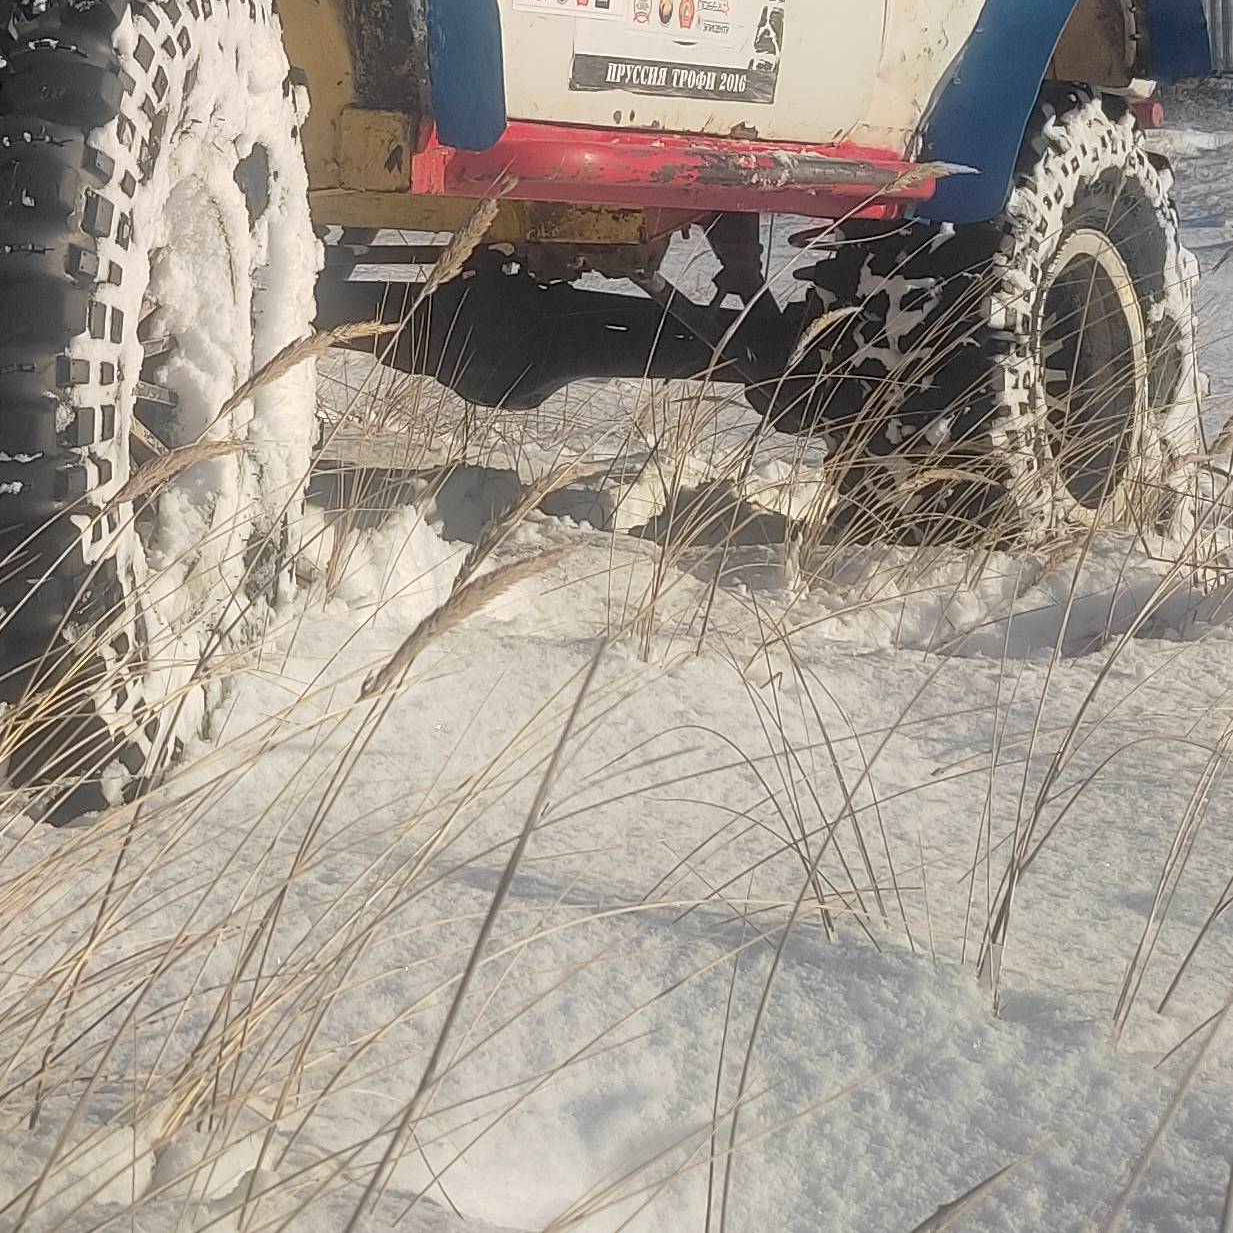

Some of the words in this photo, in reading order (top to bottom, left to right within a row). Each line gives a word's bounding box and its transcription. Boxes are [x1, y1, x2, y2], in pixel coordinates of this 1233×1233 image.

[606, 62, 668, 86] ПРУССИЯ
[671, 68, 717, 91] ТРОФИ
[718, 72, 747, 93] 2016
